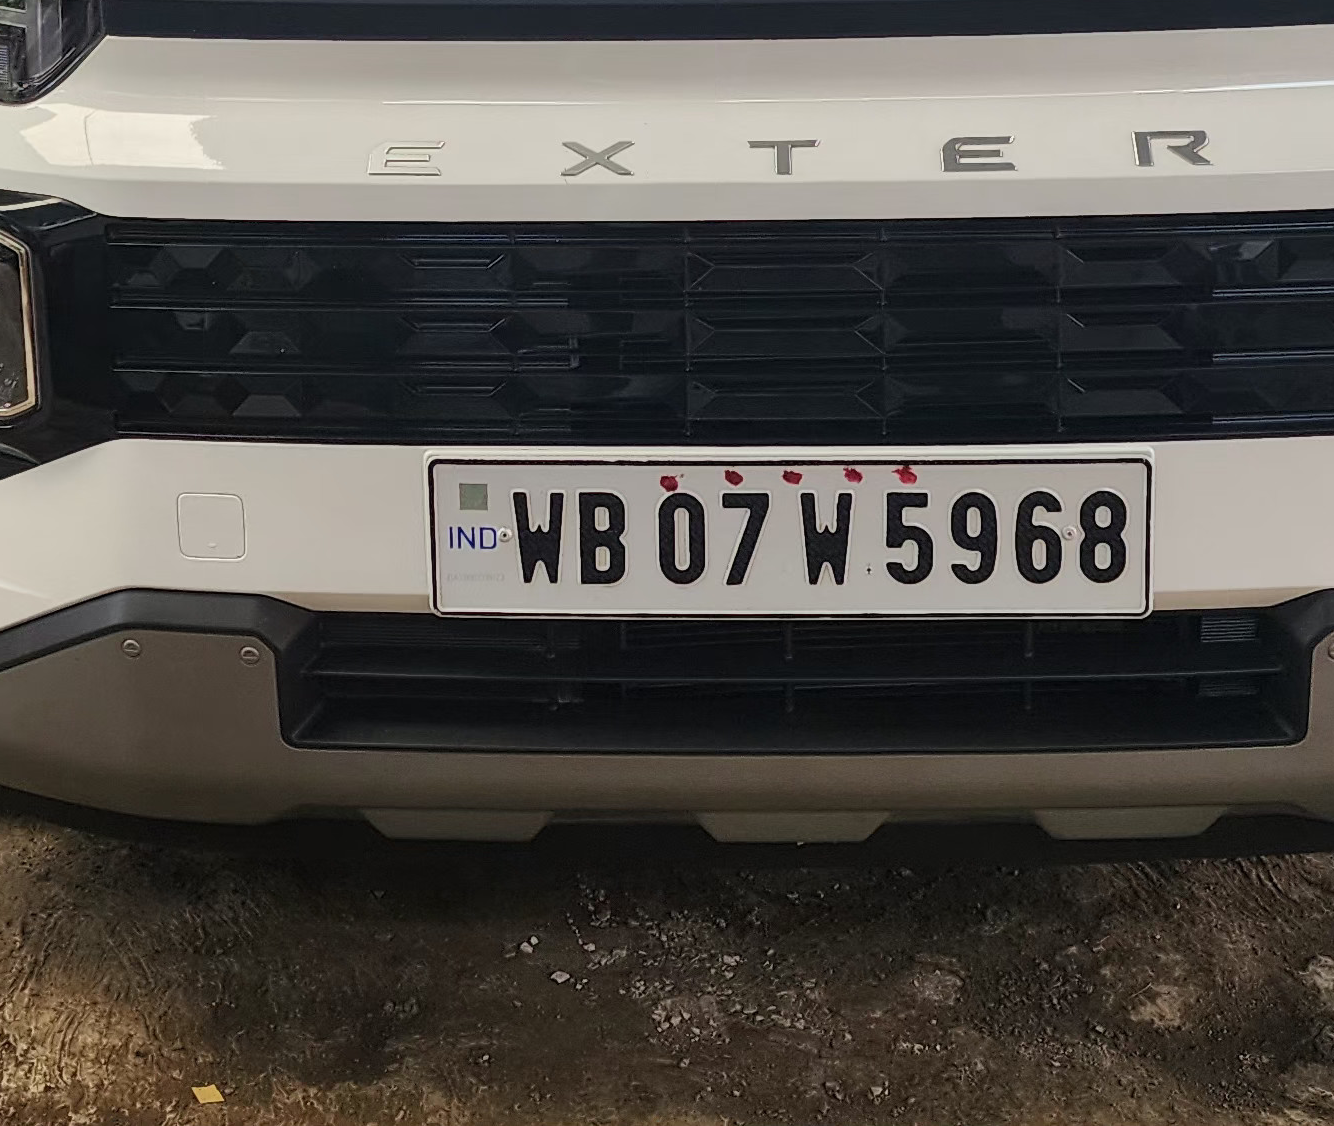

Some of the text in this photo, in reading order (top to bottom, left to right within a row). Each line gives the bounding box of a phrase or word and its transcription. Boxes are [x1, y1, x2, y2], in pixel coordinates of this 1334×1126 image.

[366, 129, 1214, 177] EXTER
[448, 489, 1128, 586] IND WB 07 W 5968
